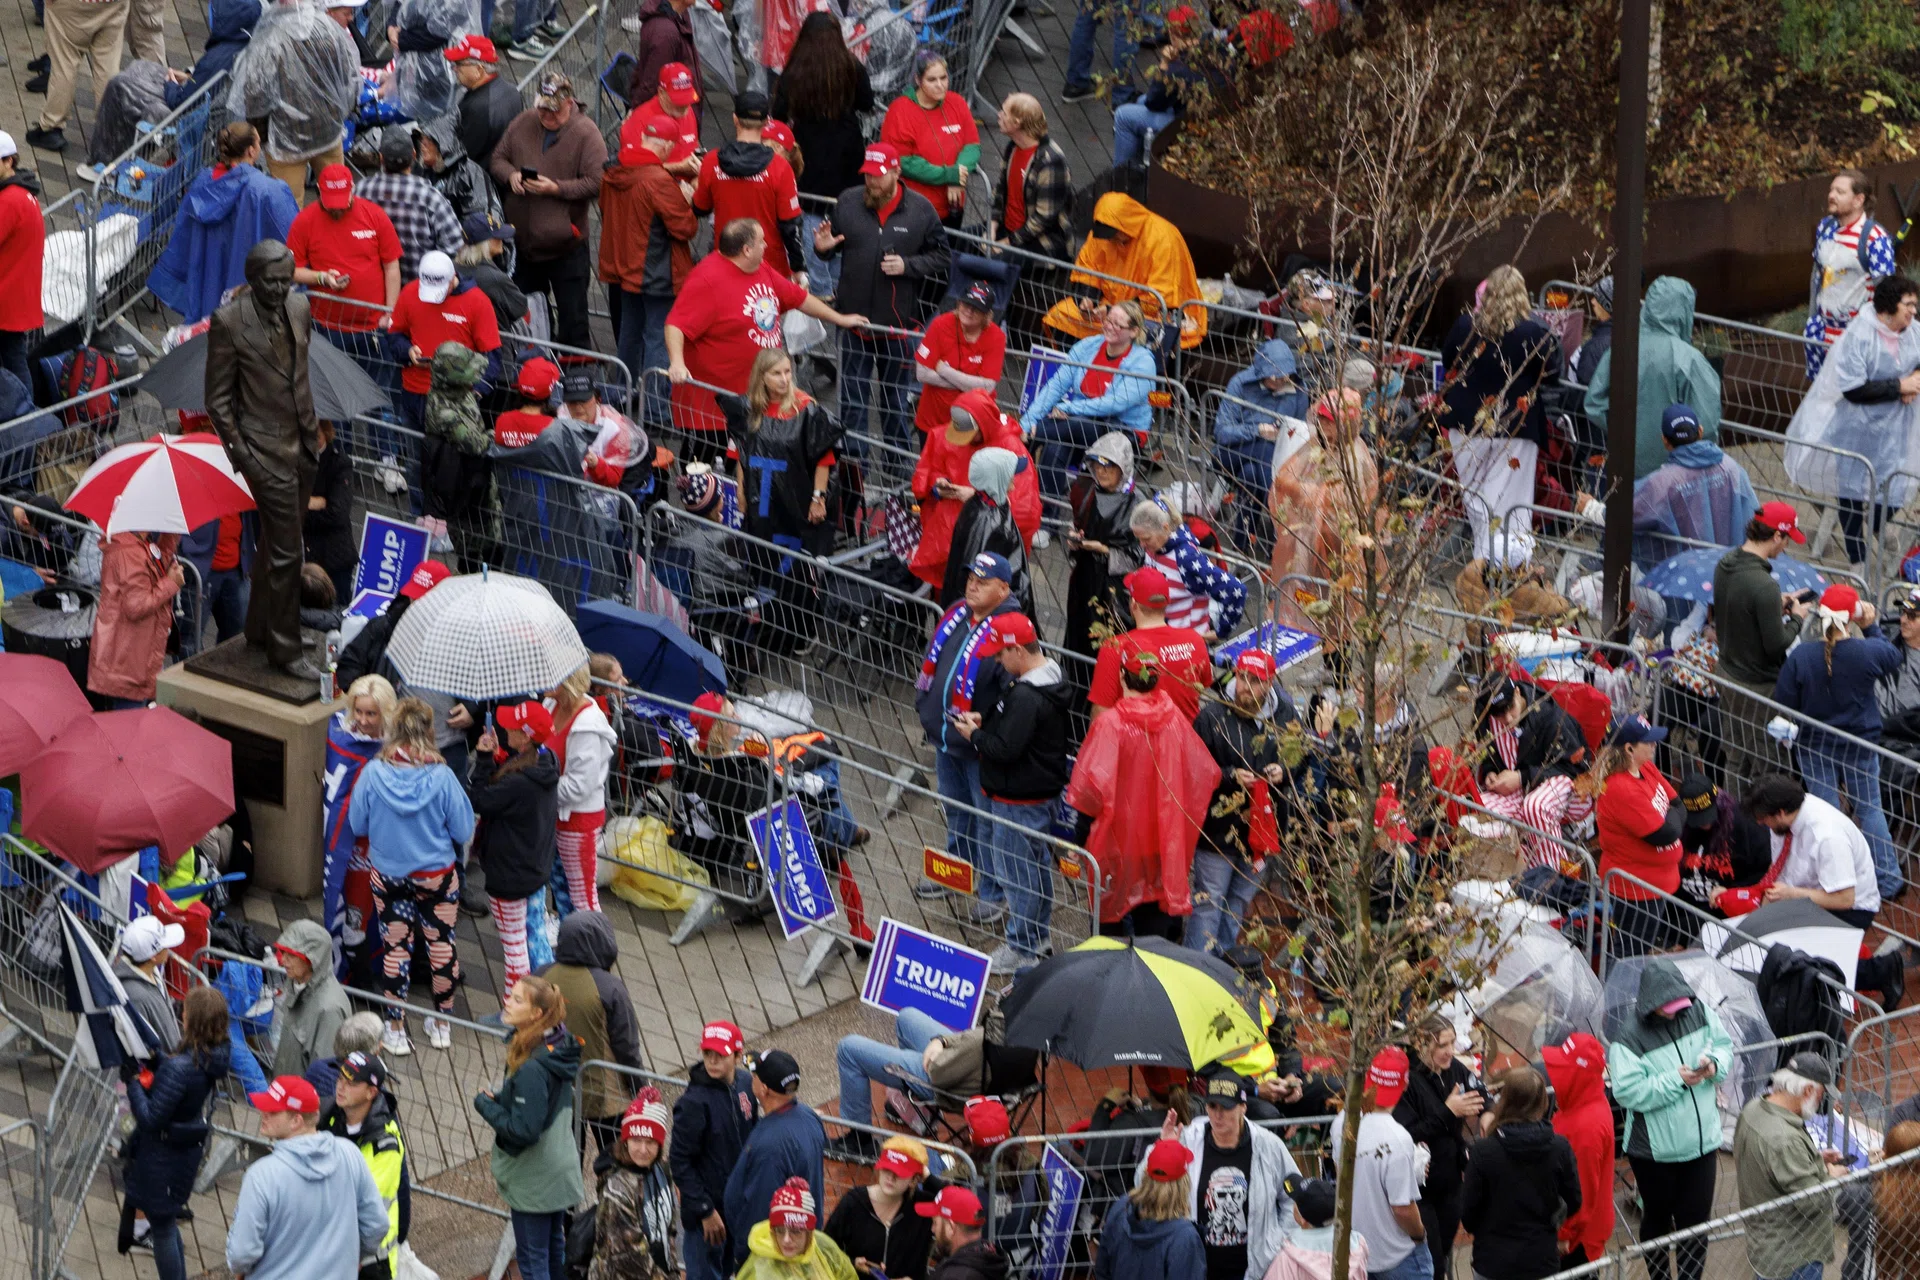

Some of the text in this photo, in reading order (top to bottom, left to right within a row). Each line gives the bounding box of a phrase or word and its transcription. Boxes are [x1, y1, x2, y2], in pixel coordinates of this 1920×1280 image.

[376, 530, 400, 592] UMP
[773, 812, 817, 916] TRUMP
[932, 858, 951, 878] USA
[895, 954, 976, 1001] TRUMP
[629, 1125, 654, 1138] MAGA
[1039, 1167, 1063, 1259] RUMP
